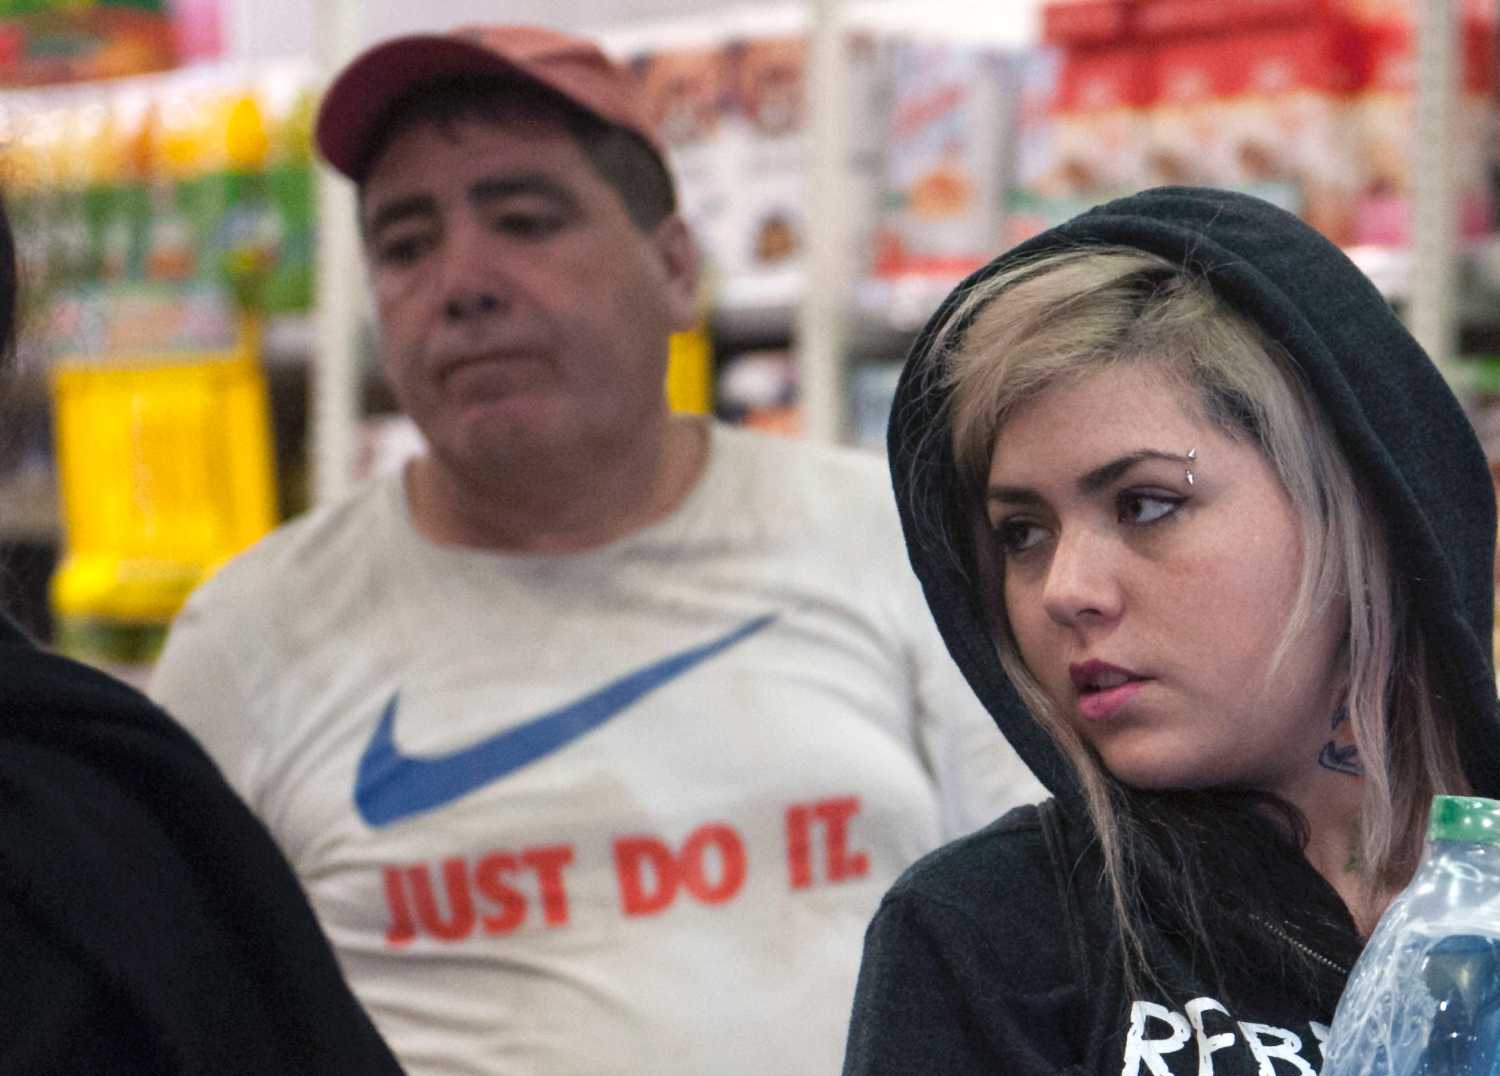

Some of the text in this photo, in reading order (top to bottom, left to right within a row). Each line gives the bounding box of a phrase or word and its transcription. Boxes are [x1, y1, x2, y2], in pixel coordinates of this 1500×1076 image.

[381, 795, 871, 950] JUST DO IT.
